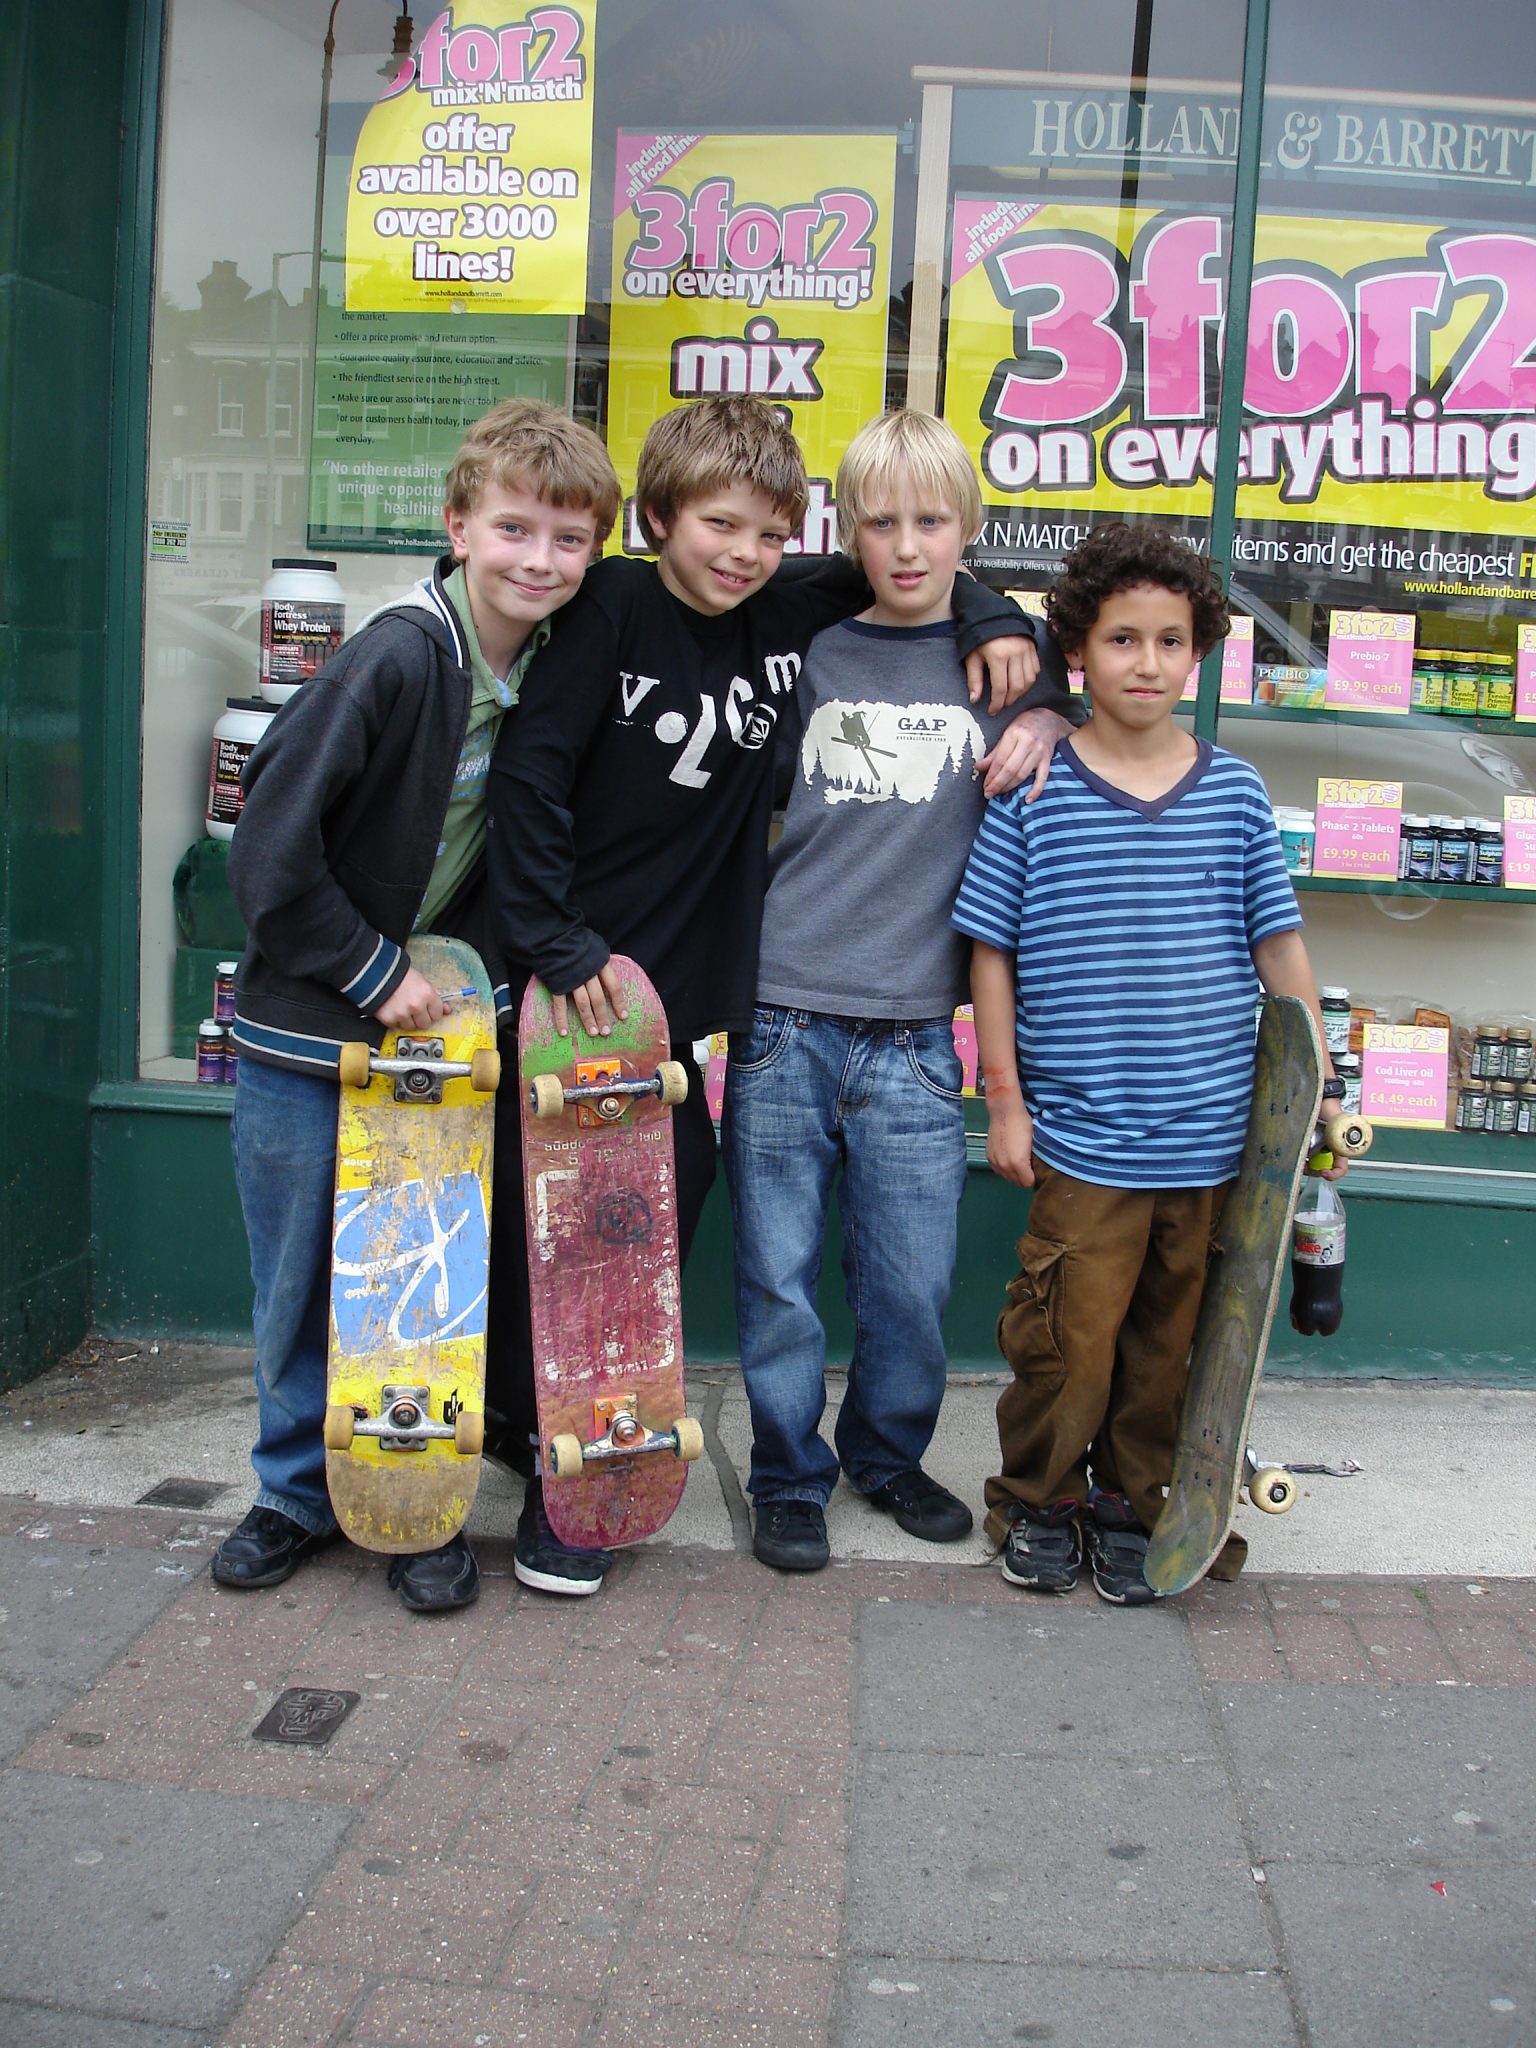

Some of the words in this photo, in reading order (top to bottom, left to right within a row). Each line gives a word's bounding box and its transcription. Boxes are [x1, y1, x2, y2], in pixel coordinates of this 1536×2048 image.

[380, 9, 583, 100] for2
[432, 75, 583, 106] mix'N'match
[424, 114, 514, 151] offer
[1028, 99, 1241, 157] HOLLAN
[1277, 111, 1322, 170] &
[358, 156, 522, 195] available
[529, 169, 578, 197] on
[625, 176, 645, 198] all
[640, 150, 674, 183] food
[376, 208, 458, 236] over
[461, 204, 556, 238] 3000
[630, 181, 873, 270] 3for2
[965, 240, 985, 263] all
[980, 215, 1015, 248] food
[414, 242, 514, 281] lines!
[625, 270, 669, 296] on
[675, 263, 872, 307] everything!
[356, 313, 388, 321] market.
[994, 217, 1536, 424] 3for2
[340, 331, 360, 341] Offer
[369, 332, 389, 343] price
[441, 334, 467, 343] return
[382, 354, 409, 364] quality
[455, 354, 495, 364] education
[497, 356, 513, 365] and
[676, 323, 818, 395] mix
[338, 373, 353, 382] The
[355, 373, 395, 383] friendliest
[396, 375, 424, 383] service
[425, 376, 437, 384] on
[438, 375, 452, 384] the
[454, 375, 472, 386] high
[337, 393, 359, 402] Make
[361, 395, 379, 403] sure
[395, 395, 435, 404] associates
[437, 397, 451, 405] are
[452, 397, 478, 405] never
[365, 414, 405, 424] customers
[407, 415, 433, 425] health
[988, 429, 1090, 486] on
[1108, 399, 1536, 497] evrything
[353, 462, 389, 476] other
[393, 463, 443, 478] retailer
[337, 480, 384, 498] unique
[993, 521, 1012, 548] N
[1016, 522, 1090, 551] MATCH
[1023, 560, 1045, 571] Offers
[1047, 562, 1066, 572] vlid
[1293, 536, 1336, 565] and
[1340, 542, 1376, 573] get
[1380, 540, 1415, 571] the
[1418, 543, 1515, 582] cheapest
[274, 602, 295, 611] Body
[274, 610, 308, 620] Fortress
[274, 620, 298, 634] Whey
[300, 620, 331, 633] Protein
[1336, 613, 1397, 638] 3for2
[1350, 651, 1381, 661] Prebio
[1383, 652, 1390, 662] 7
[1259, 668, 1310, 680] PREBIO
[1334, 680, 1369, 693] £9.99
[1373, 683, 1402, 695] each
[897, 717, 947, 731] GAP
[219, 742, 239, 753] Body
[219, 751, 249, 761] Fortress
[219, 759, 241, 774] Whey
[1324, 780, 1385, 805] 3for2
[1321, 820, 1350, 831] Phase
[1352, 822, 1358, 832] 2
[1361, 823, 1395, 834] Tablets
[1323, 847, 1358, 860] £9.99
[1361, 850, 1391, 862] each
[1508, 862, 1536, 873] £19.
[1369, 1026, 1429, 1049] 3for2
[1375, 1066, 1393, 1075] Cod
[1395, 1067, 1418, 1077] Liver
[1420, 1068, 1433, 1078] Oil
[1369, 1092, 1404, 1105] £4.49
[1408, 1095, 1437, 1107] each
